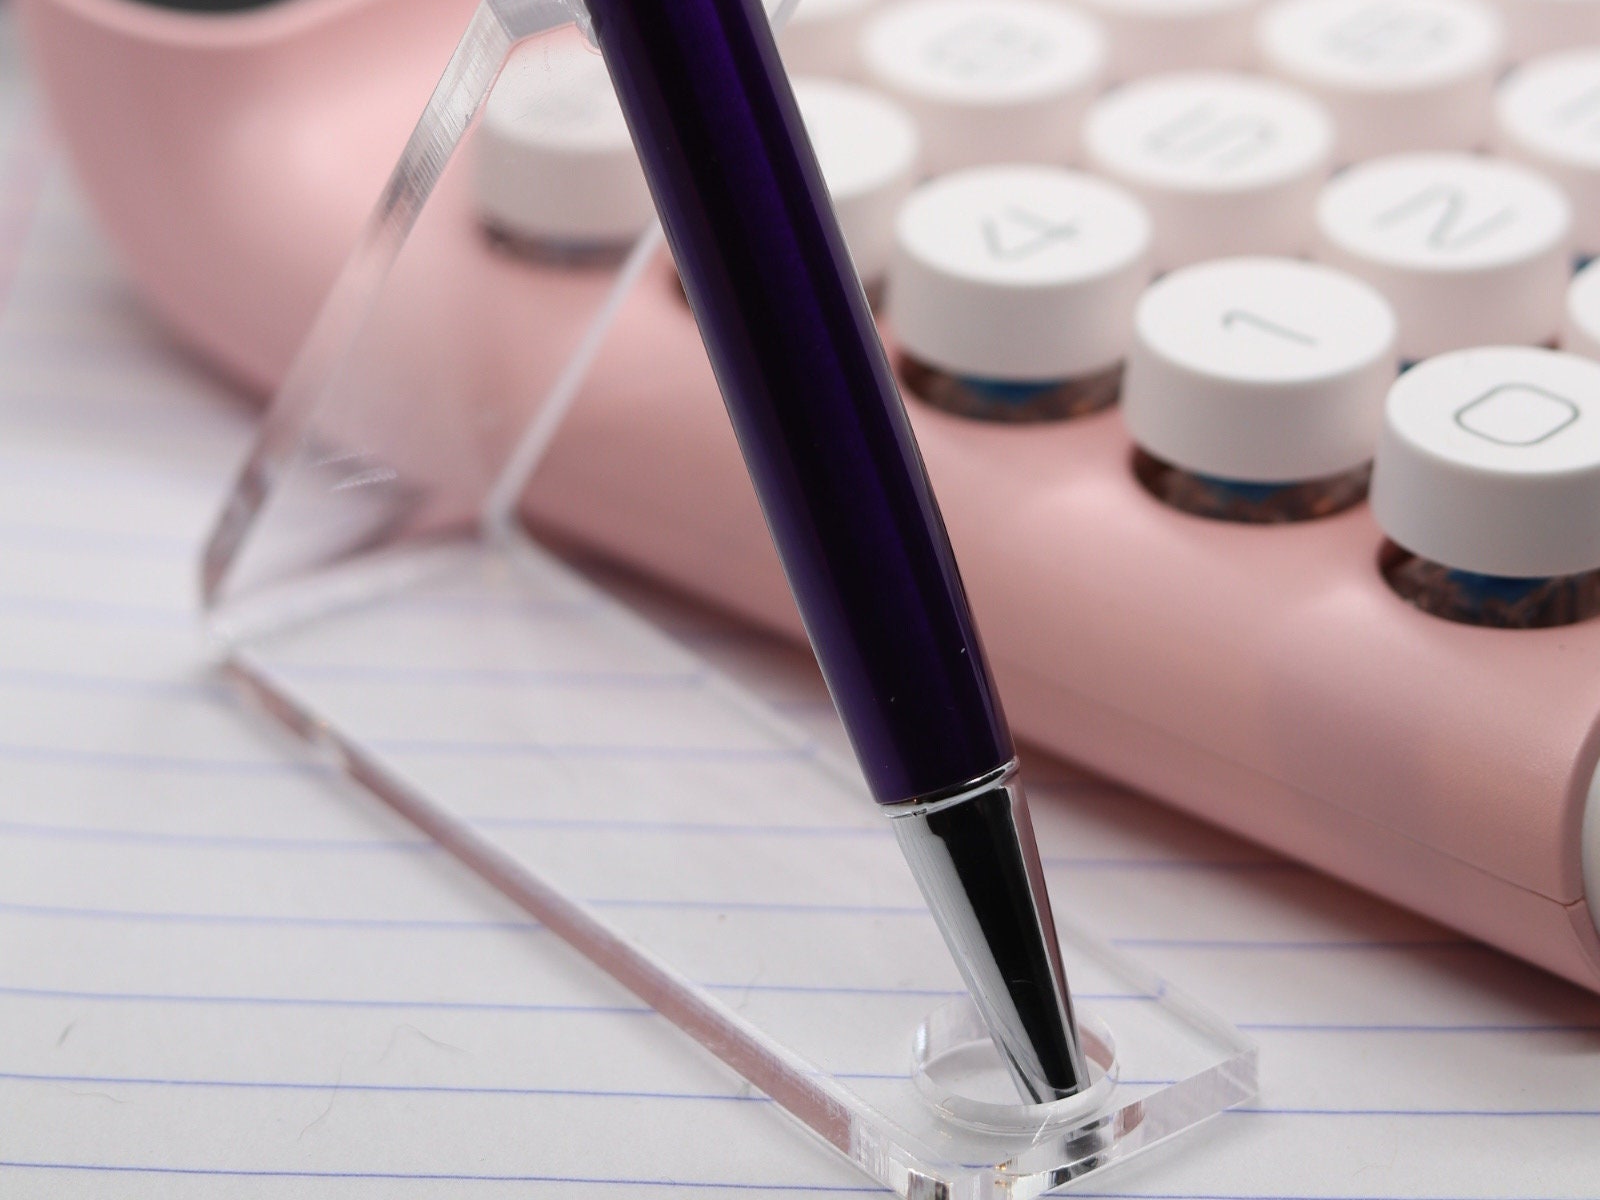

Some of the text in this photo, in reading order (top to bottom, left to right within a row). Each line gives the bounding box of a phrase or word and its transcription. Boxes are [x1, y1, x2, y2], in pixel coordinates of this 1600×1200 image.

[980, 204, 1080, 263] 4
[1370, 182, 1518, 252] 2
[1219, 308, 1320, 348] 1
[1452, 381, 1582, 448] 0
